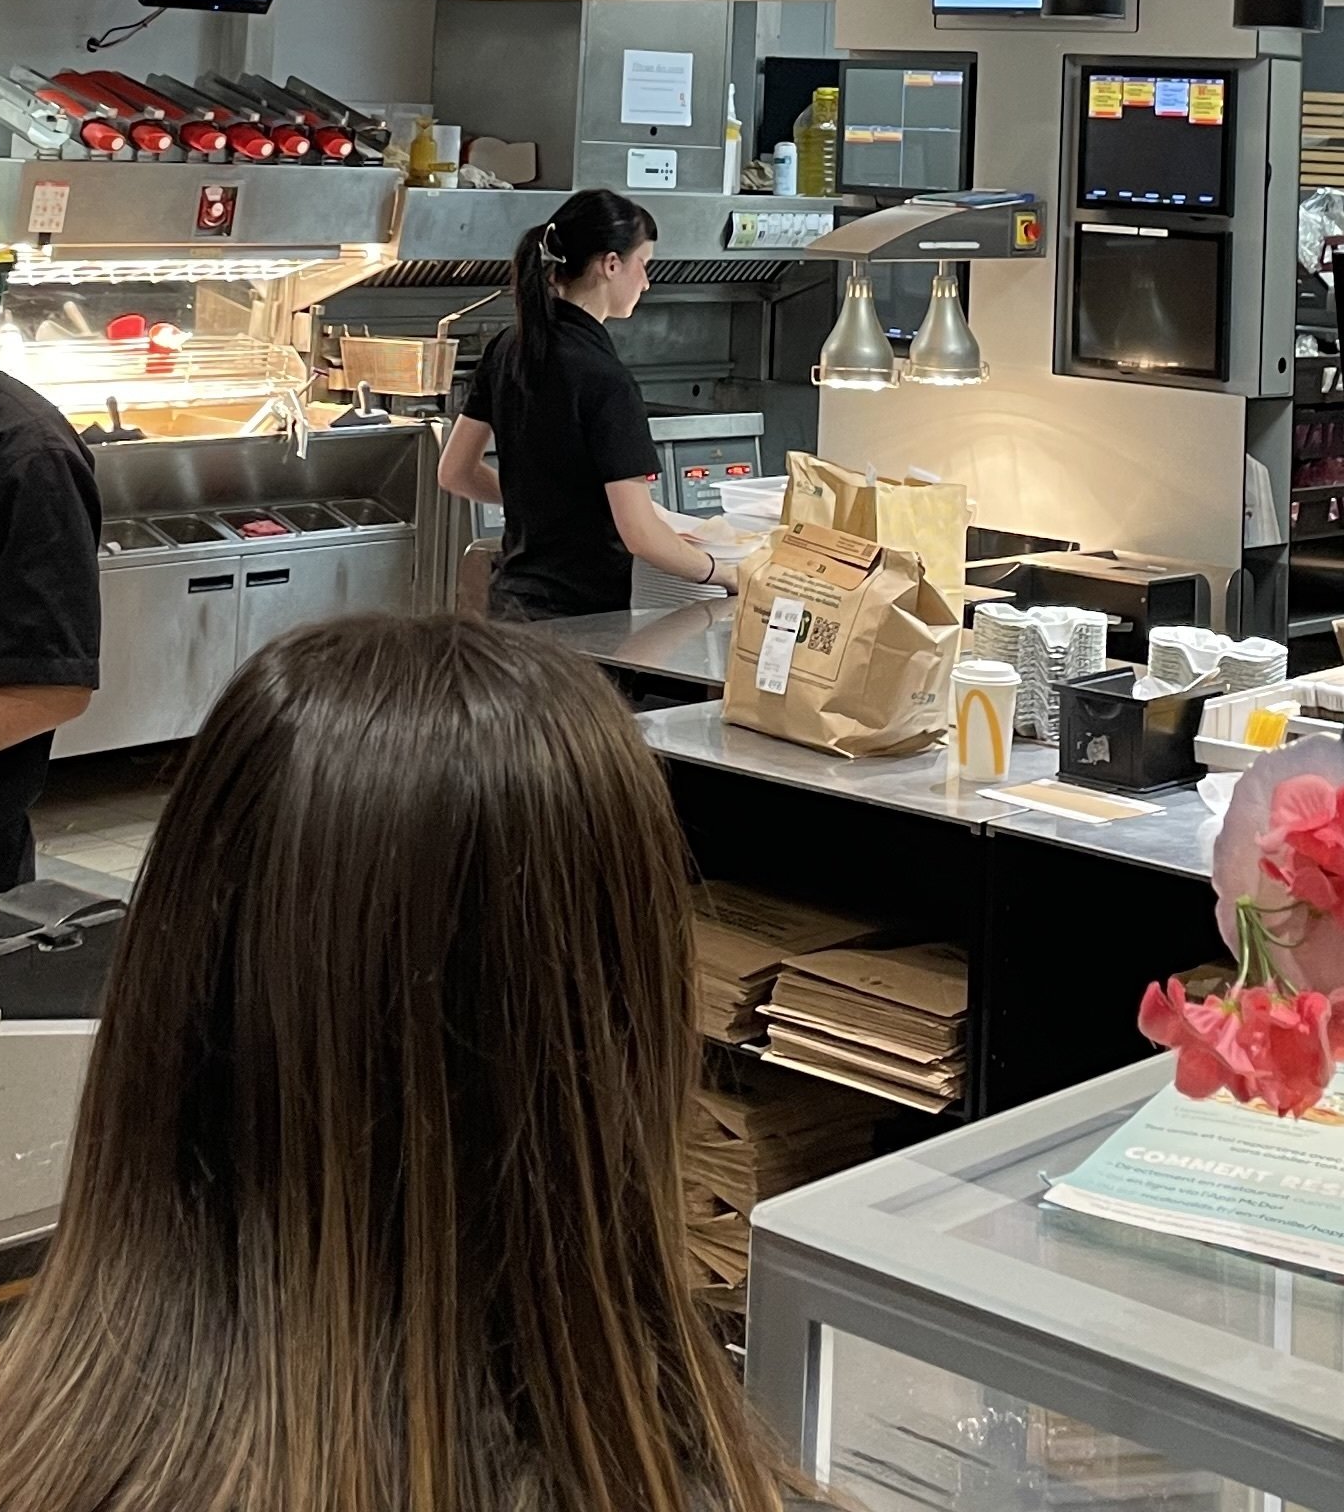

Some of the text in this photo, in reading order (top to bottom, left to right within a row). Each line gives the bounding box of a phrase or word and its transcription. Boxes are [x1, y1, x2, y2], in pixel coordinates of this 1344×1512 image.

[1124, 1146, 1274, 1183] COMMENT
[1217, 1135, 1236, 1143] toi
[1309, 1152, 1343, 1165] avec
[1229, 1146, 1261, 1156] sans
[1262, 1152, 1312, 1165] oublier
[1314, 1161, 1339, 1170] ton
[1115, 1162, 1196, 1183] Directement
[1198, 1179, 1215, 1187] en
[1216, 1182, 1290, 1199] restaurant
